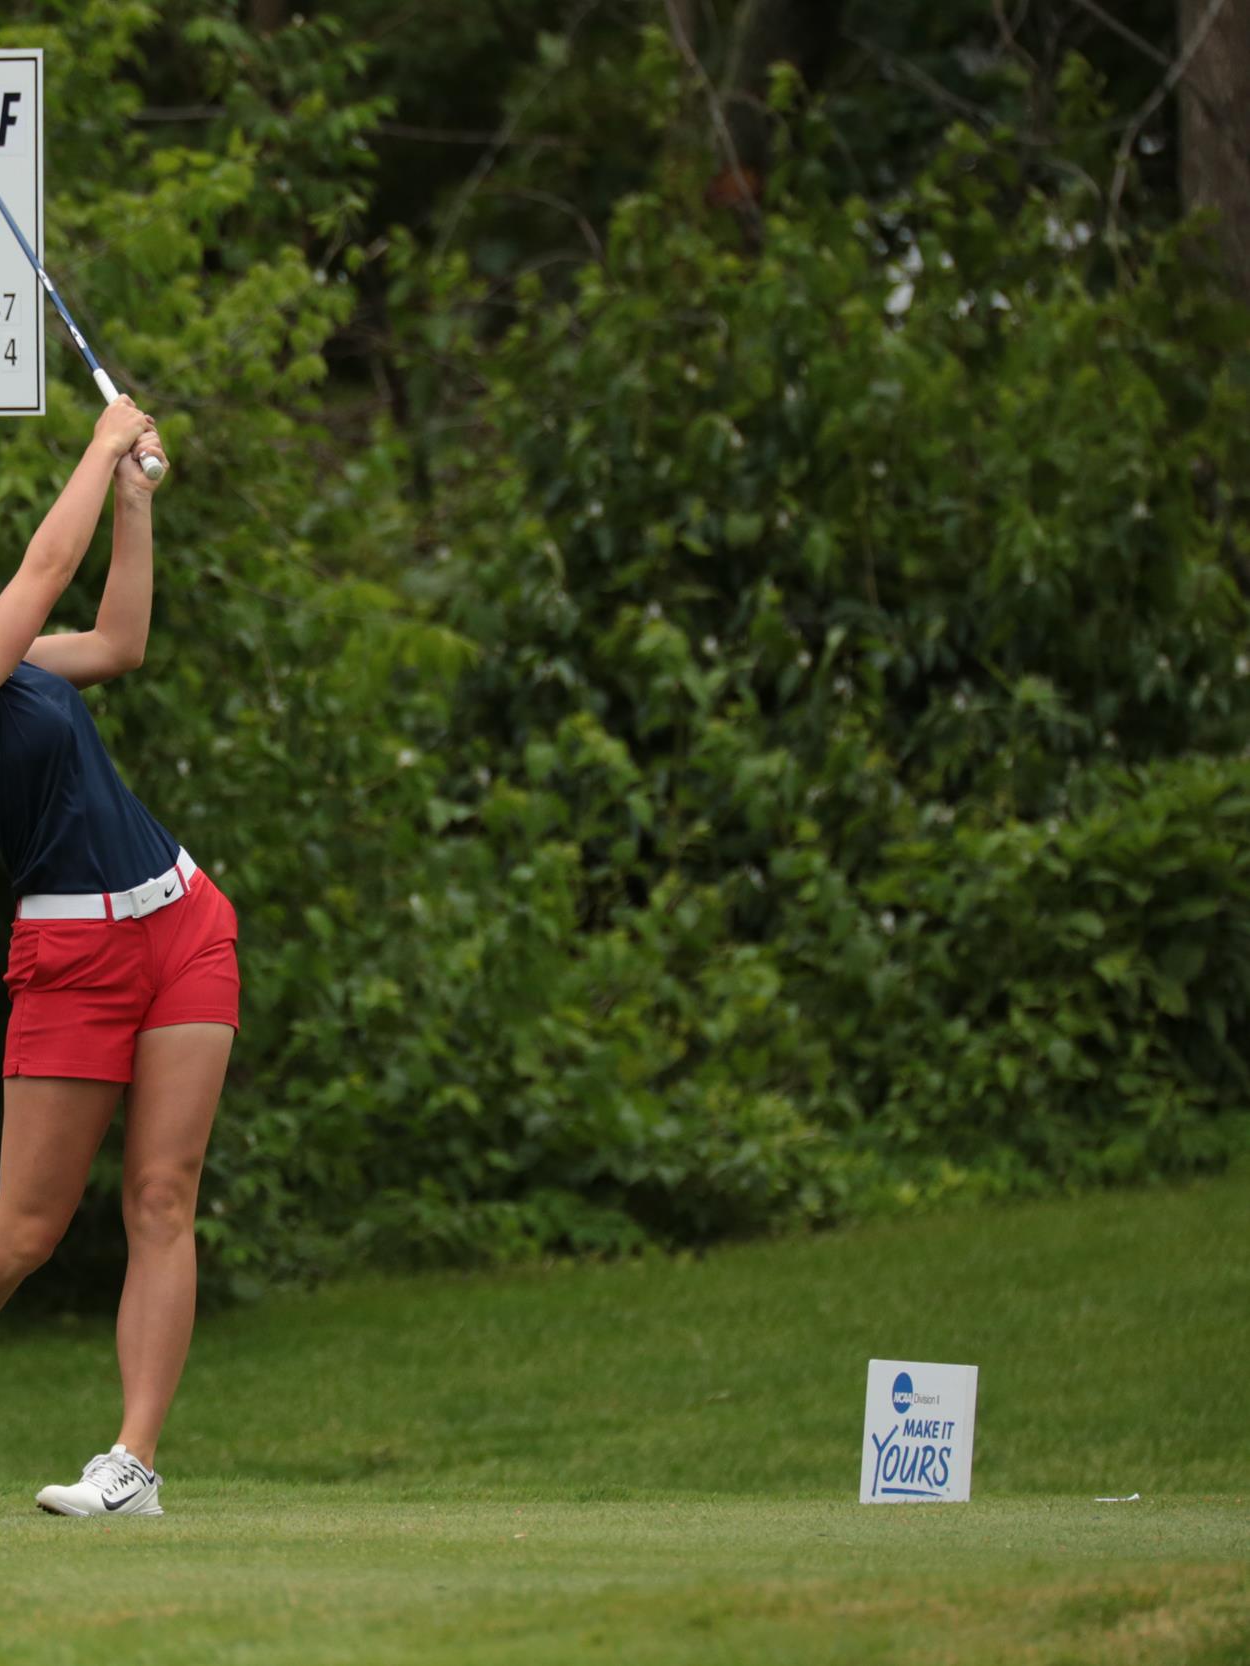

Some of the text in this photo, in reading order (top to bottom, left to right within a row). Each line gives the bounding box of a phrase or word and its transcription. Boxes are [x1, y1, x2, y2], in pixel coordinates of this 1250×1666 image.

[4, 338, 18, 366] 4
[914, 1393, 935, 1405] Division
[903, 1419, 955, 1440] MAKE IT
[872, 1424, 952, 1497] YOURS
